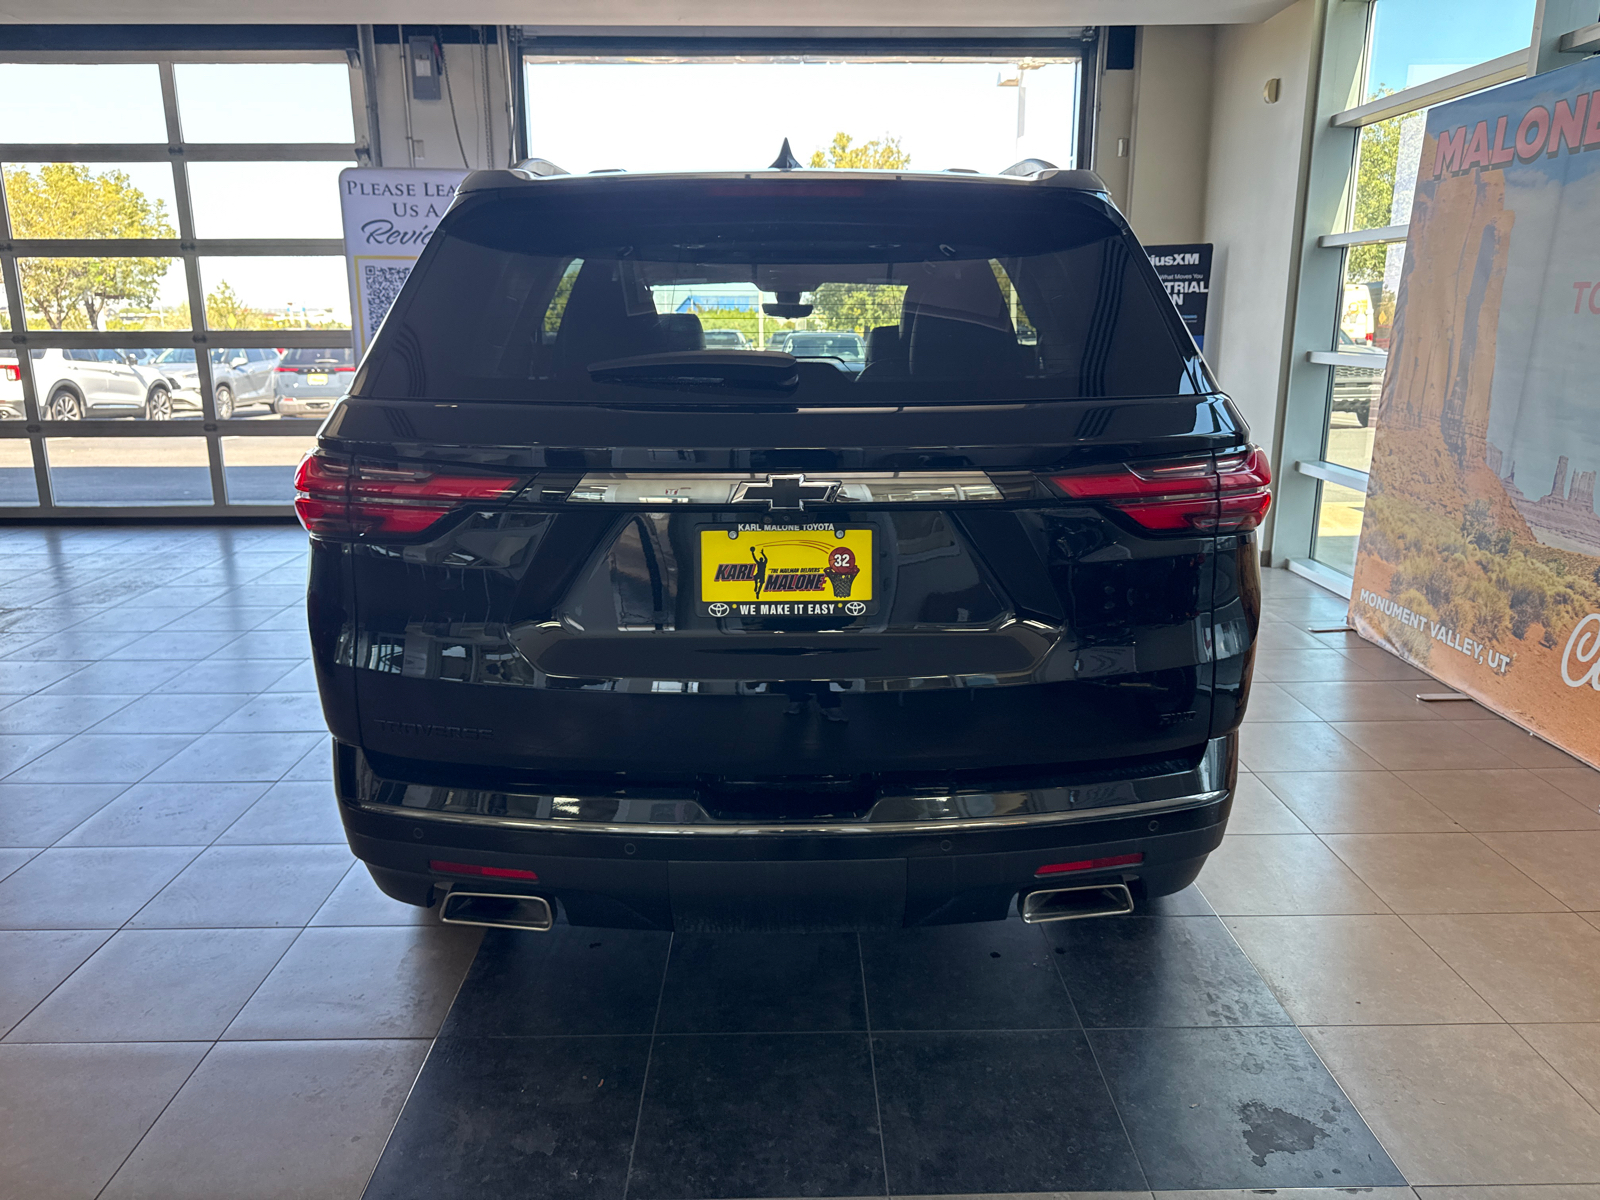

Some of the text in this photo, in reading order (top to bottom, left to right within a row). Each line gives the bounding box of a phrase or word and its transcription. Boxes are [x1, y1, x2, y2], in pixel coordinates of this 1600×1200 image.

[346, 180, 457, 197] PLEASE LEA
[392, 202, 440, 218] US A
[1149, 253, 1199, 266] iusXM
[1164, 281, 1209, 293] TRIAL
[1169, 293, 1184, 306] N
[738, 523, 761, 531] KARL
[802, 523, 835, 531] TOYOTA
[834, 554, 850, 567] 32
[714, 563, 757, 582] KARL
[763, 573, 827, 592] MALONE
[740, 603, 835, 615] WE MAKE IT EASY
[1360, 588, 1510, 673] MONUMENT VALLEY, UT
